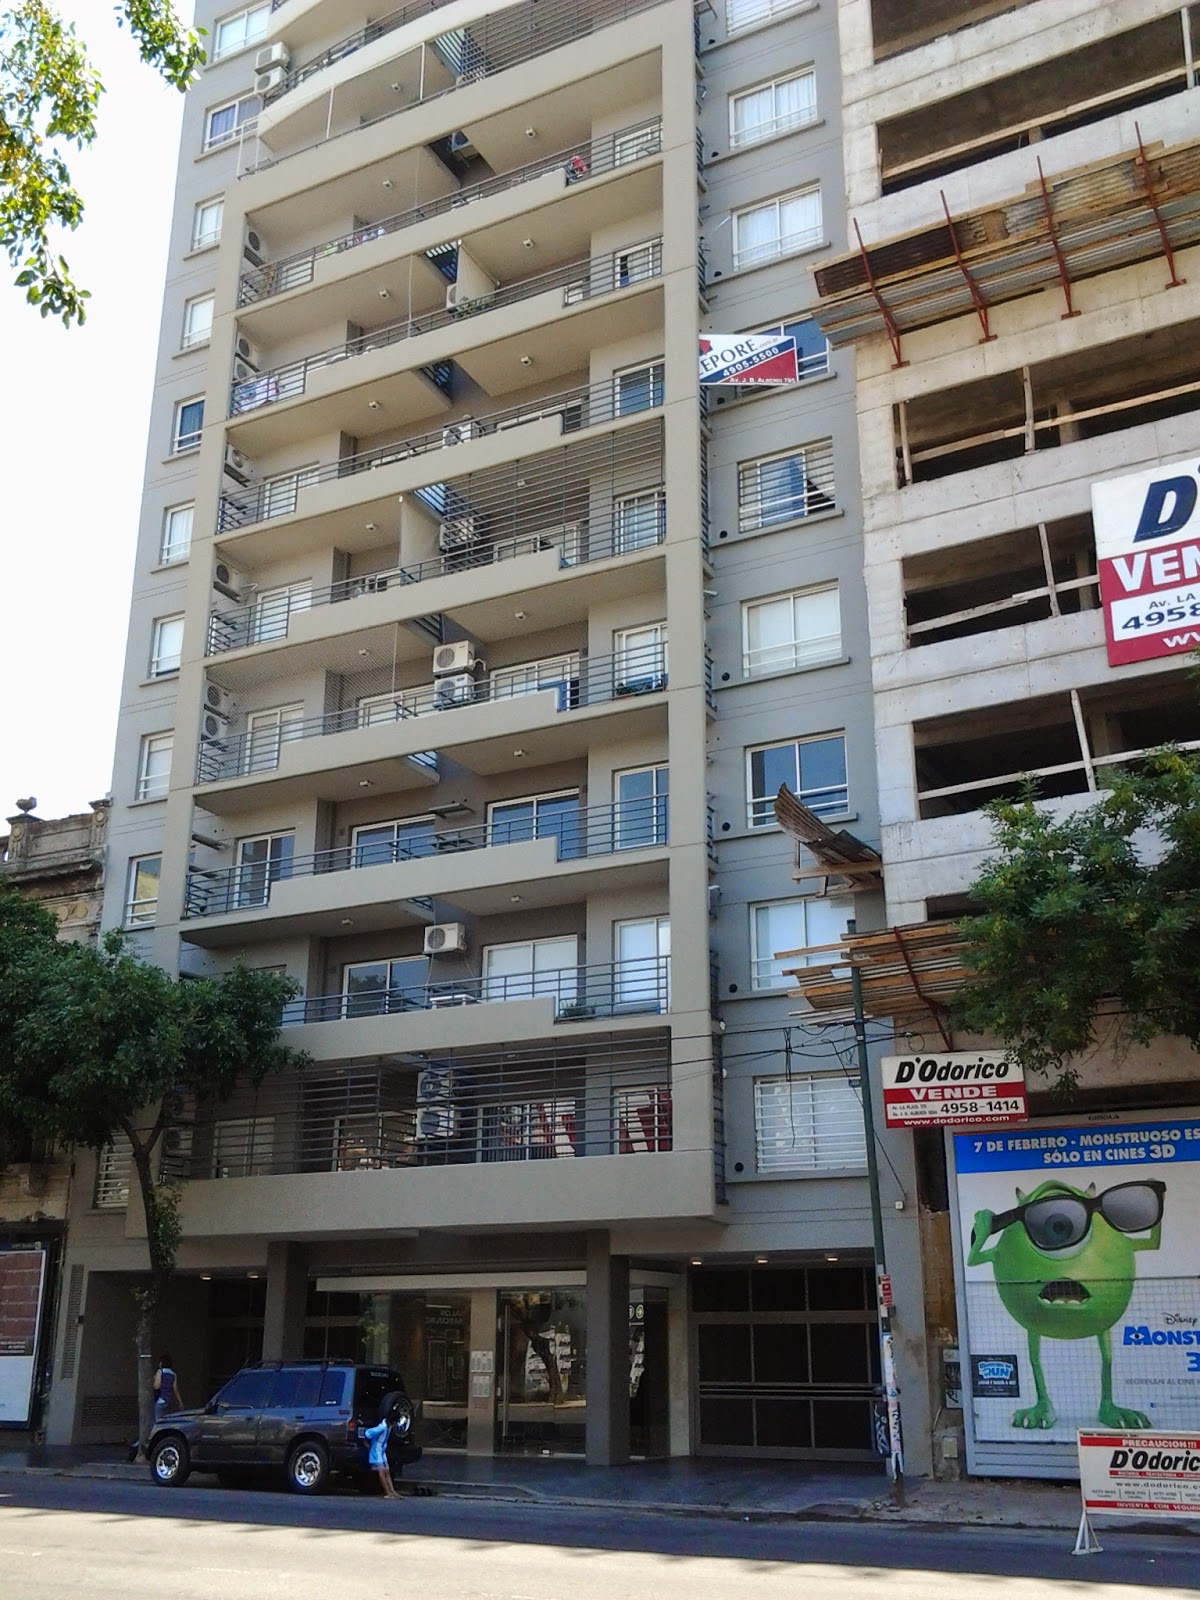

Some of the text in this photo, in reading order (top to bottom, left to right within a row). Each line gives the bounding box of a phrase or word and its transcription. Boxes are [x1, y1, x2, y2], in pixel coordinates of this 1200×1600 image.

[722, 346, 780, 377] 4905-5500
[1133, 464, 1200, 543] D
[895, 1057, 1009, 1083] D'Odorico
[910, 1085, 997, 1100] VENDE
[940, 1100, 1020, 1114] 4958-1414
[903, 1115, 1010, 1126] www.dodorico.com
[974, 1141, 982, 1153] 7
[986, 1140, 1003, 1152] DE
[1008, 1136, 1067, 1151] FEBRERO
[1079, 1128, 1181, 1147] MONSTRUOSO
[1043, 1144, 1176, 1164] SÓLO EN CINES 3D
[1121, 1438, 1197, 1449] PRECAUCION!!!
